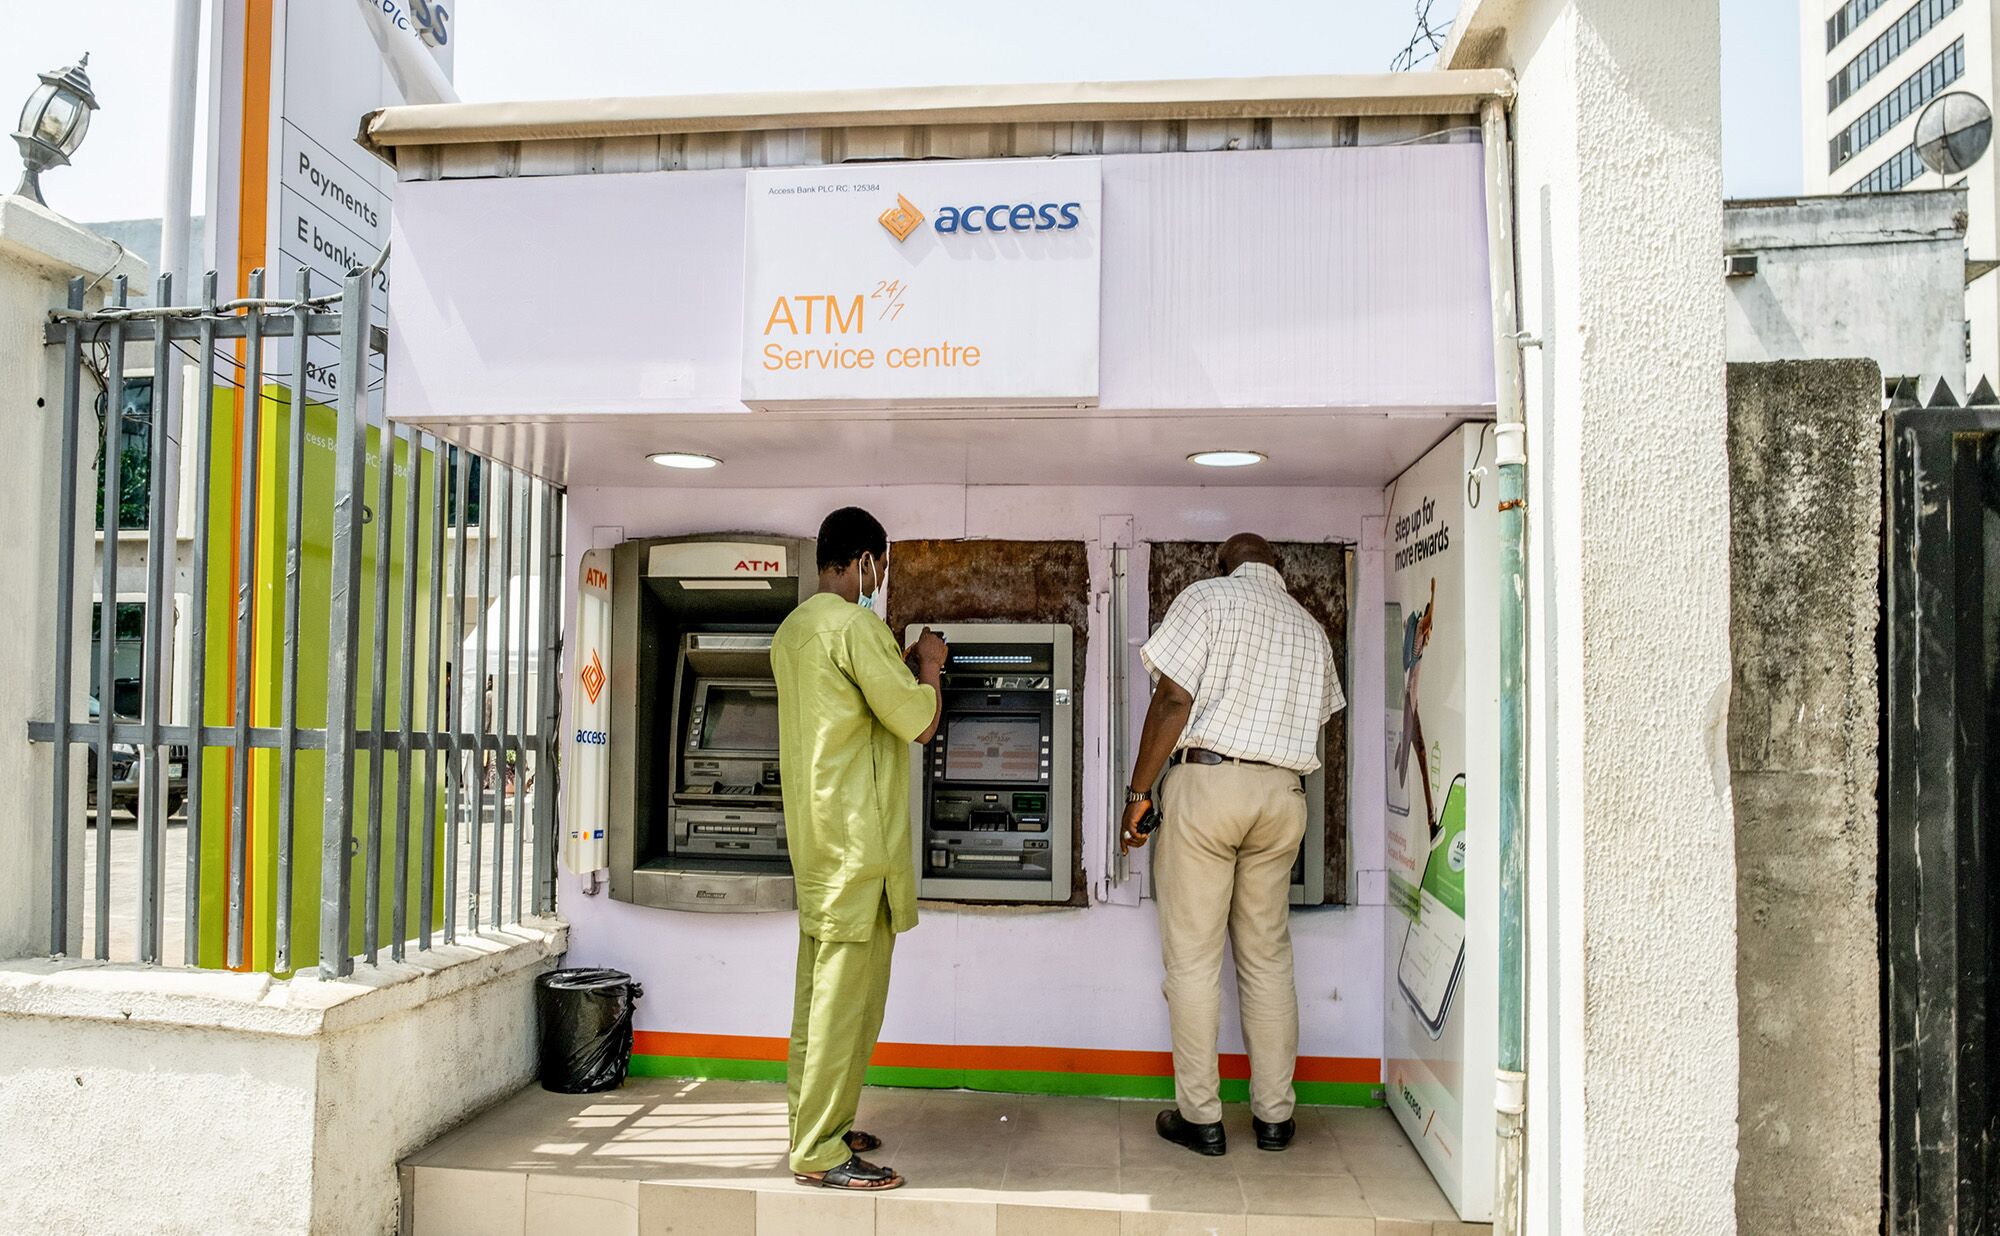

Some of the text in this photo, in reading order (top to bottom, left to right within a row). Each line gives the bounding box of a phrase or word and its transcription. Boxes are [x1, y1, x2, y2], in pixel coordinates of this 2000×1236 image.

[299, 151, 378, 228] Payments
[768, 187, 795, 195] Access
[796, 185, 816, 194] Bank
[817, 185, 834, 193] PLC
[853, 184, 880, 192] 125384
[298, 216, 309, 243] E
[935, 202, 1081, 234] access
[763, 294, 865, 336] ATM
[762, 341, 981, 371] Service centre
[306, 361, 337, 389] axe
[1395, 496, 1436, 542] step up for
[1395, 520, 1449, 573] more rewards
[586, 567, 607, 590] ATM
[734, 560, 779, 572] ATM
[576, 729, 607, 745] access
